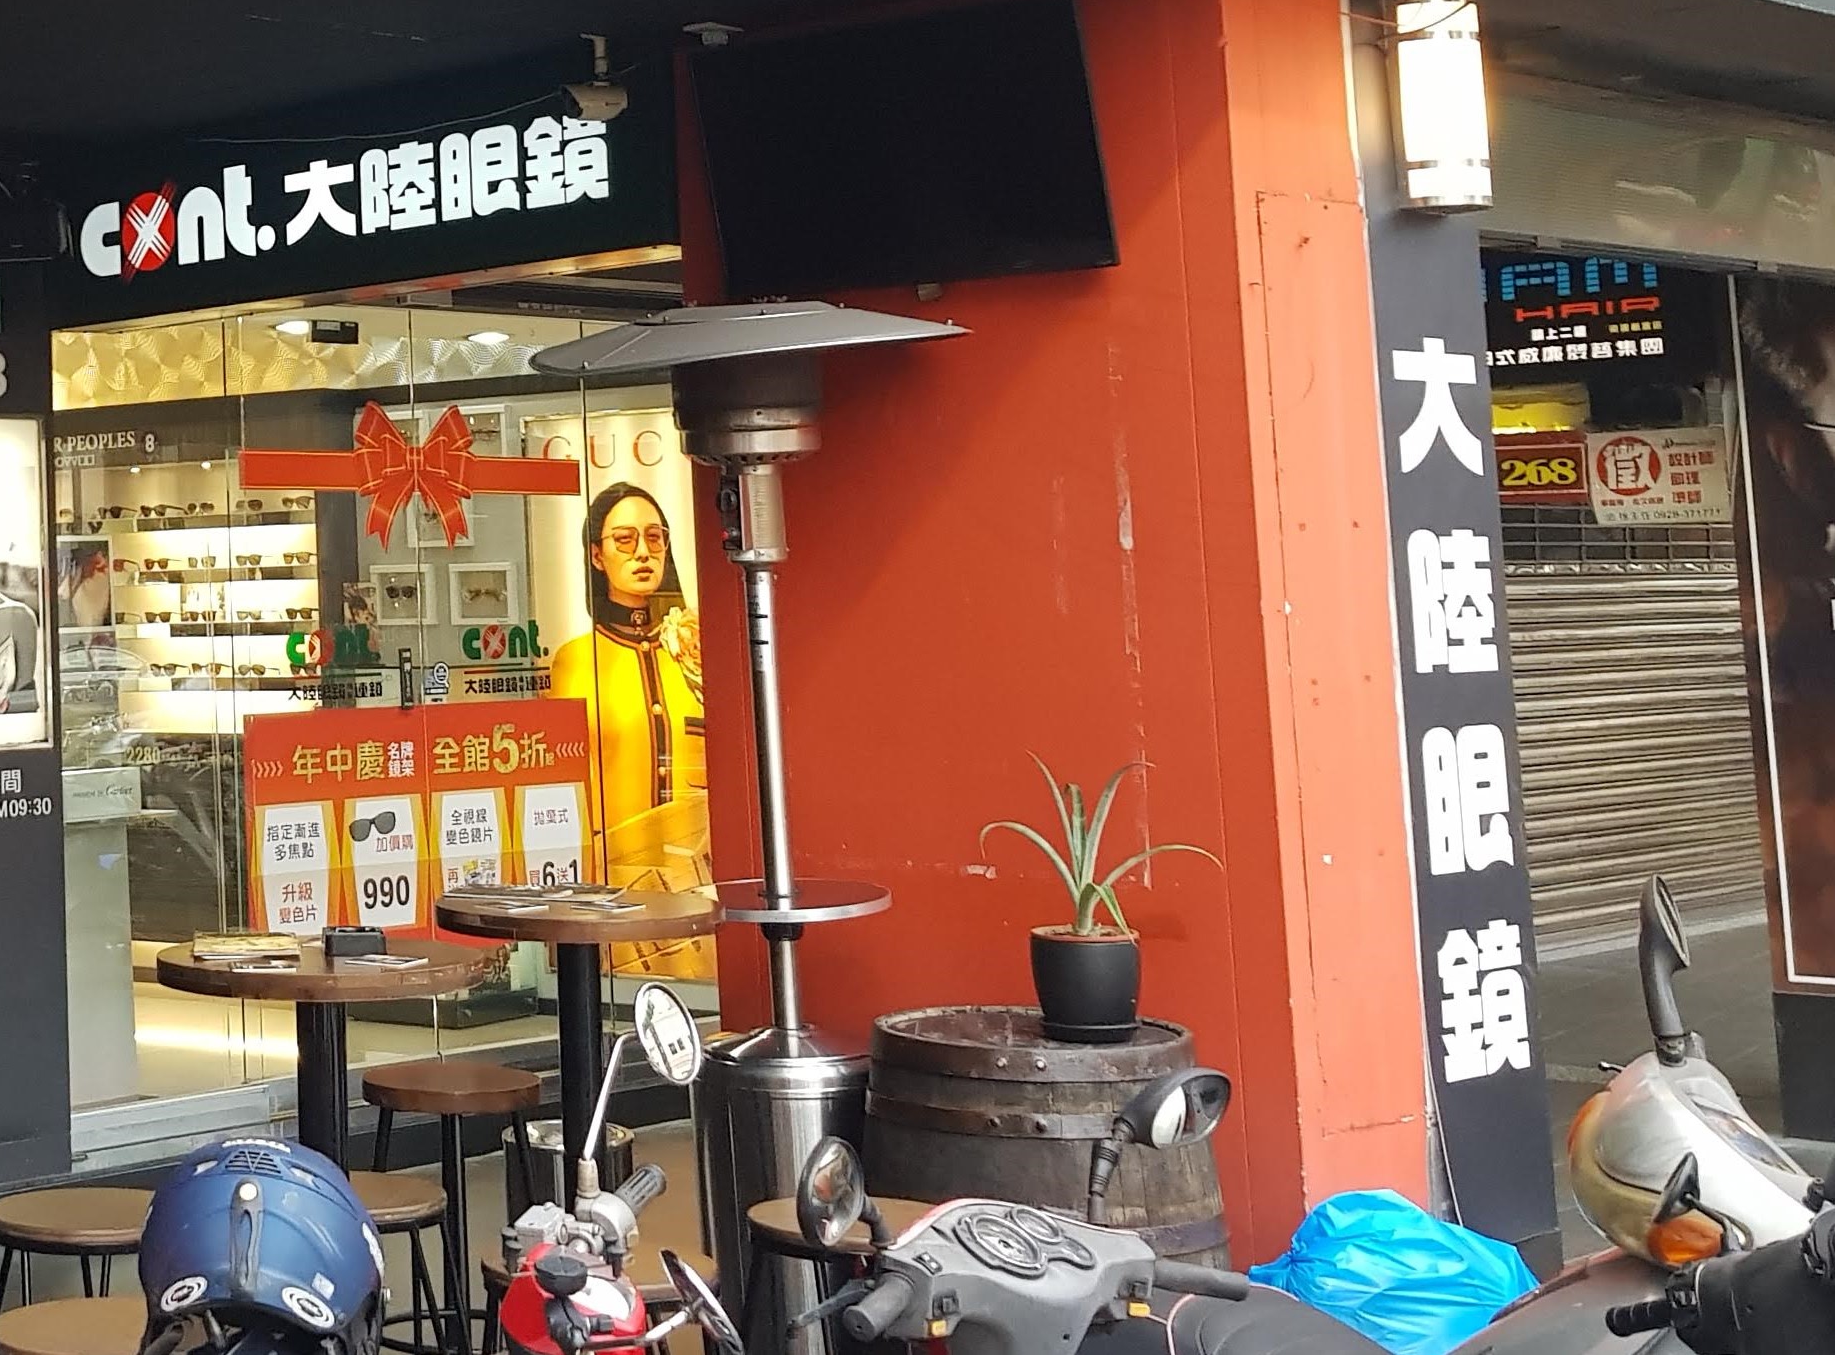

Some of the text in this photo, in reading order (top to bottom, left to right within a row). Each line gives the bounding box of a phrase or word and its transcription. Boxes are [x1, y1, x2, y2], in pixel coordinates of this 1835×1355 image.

[283, 115, 610, 246] 大陸眼鏡
[67, 431, 136, 453] PEOPLES
[1501, 457, 1577, 486] 268
[1392, 336, 1532, 1085] 大陸眼鏡
[292, 740, 386, 783] 年中慶
[387, 741, 414, 759] 名牌
[274, 842, 315, 861] 多焦點
[281, 881, 313, 903] 升級
[363, 874, 410, 910] 990
